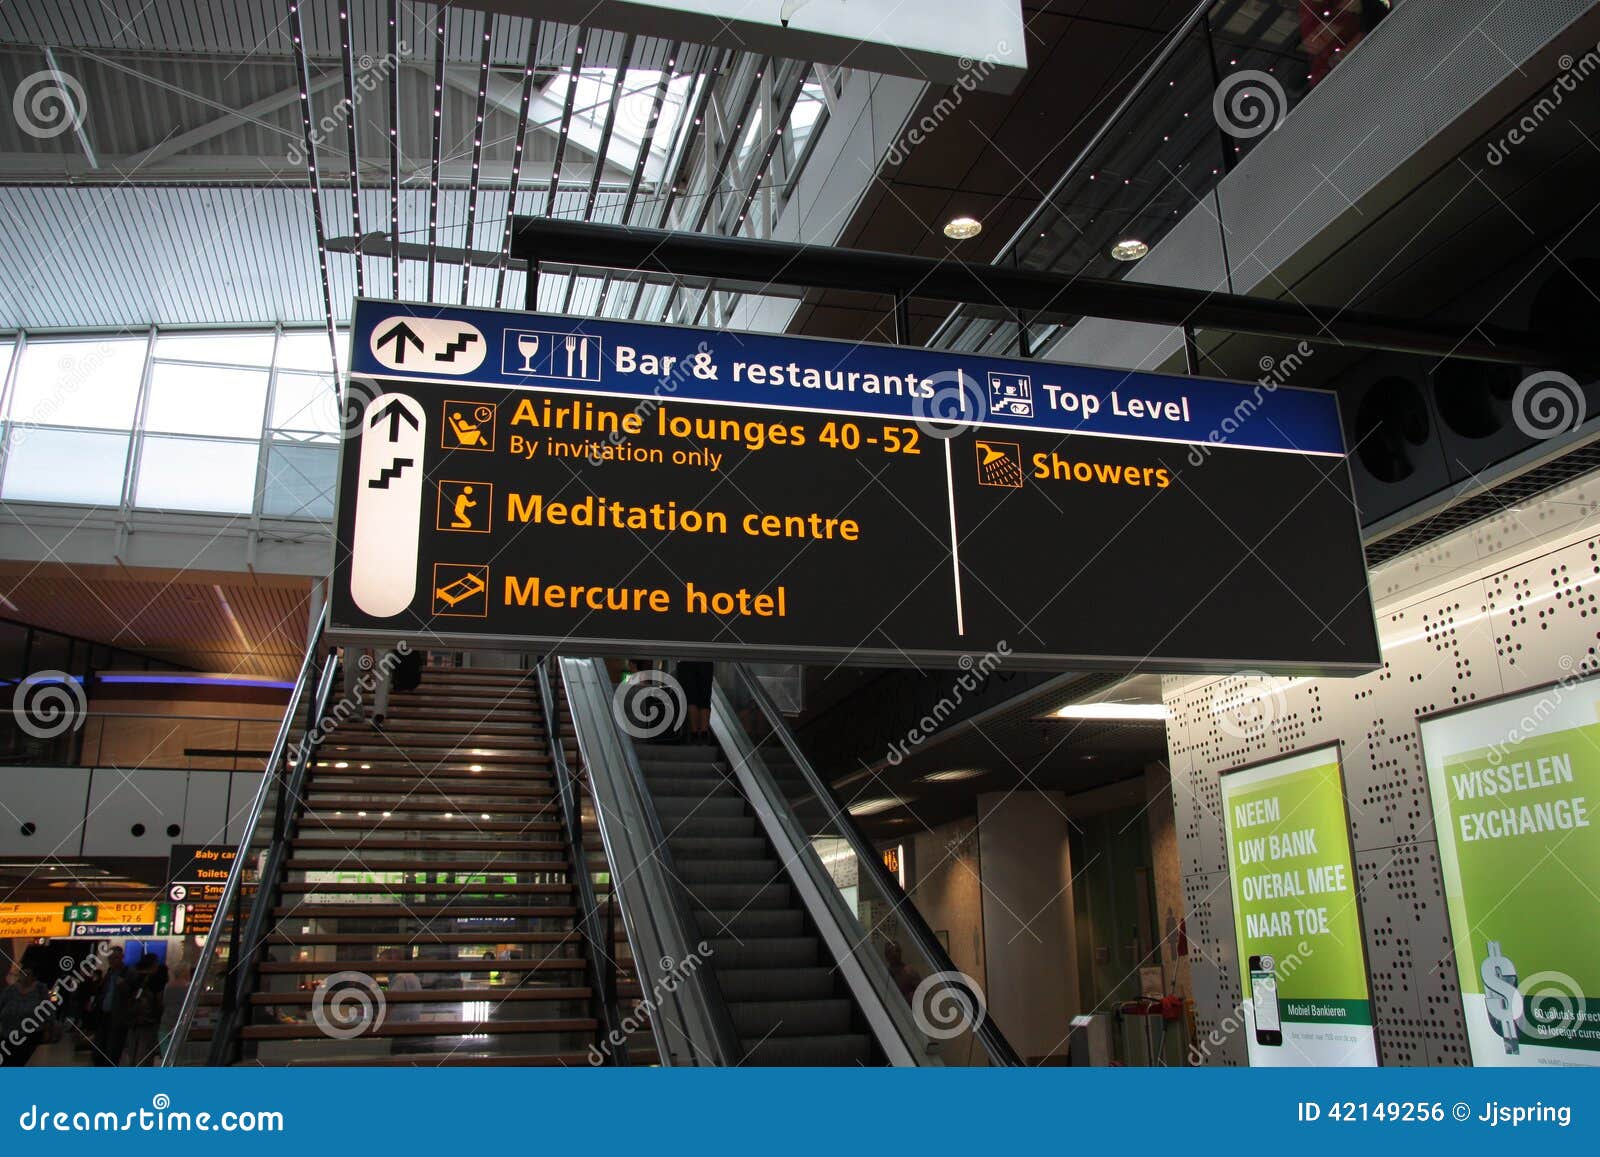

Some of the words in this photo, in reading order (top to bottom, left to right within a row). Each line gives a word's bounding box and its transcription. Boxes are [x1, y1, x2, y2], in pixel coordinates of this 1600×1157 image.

[615, 345, 677, 376] Bar
[693, 352, 719, 381] &
[732, 361, 936, 399] restaurants
[1043, 384, 1100, 419] Top
[1112, 391, 1190, 422] Level
[511, 398, 643, 434] Airline
[658, 407, 806, 450] lounges
[510, 435, 538, 459] By
[547, 437, 663, 463] invitation
[672, 447, 723, 471] only
[1033, 453, 1170, 488] Showers
[507, 493, 727, 534] Meditation
[743, 512, 860, 541] centre
[504, 576, 670, 613] Mercure
[686, 582, 786, 617] hotel
[1452, 753, 1573, 800] WISSELEN
[1235, 797, 1280, 828] NEEM
[1459, 797, 1590, 842] EXCHANGE
[195, 851, 219, 860] Baby
[221, 851, 236, 859] car
[1238, 837, 1265, 865] UW
[1269, 828, 1319, 860] BANK
[197, 869, 228, 879] Toilets
[204, 885, 223, 894] Smo
[1242, 871, 1305, 901] OVERAL
[1307, 864, 1347, 894] MEE
[0, 916, 33, 925] aggage
[0, 926, 28, 934] rrivals
[1246, 911, 1292, 938] NAAR
[1294, 907, 1329, 935] TOE
[1287, 1004, 1310, 1016] Mobiel
[1311, 1004, 1346, 1017] Bankieren
[1579, 1030, 1600, 1040] curre
